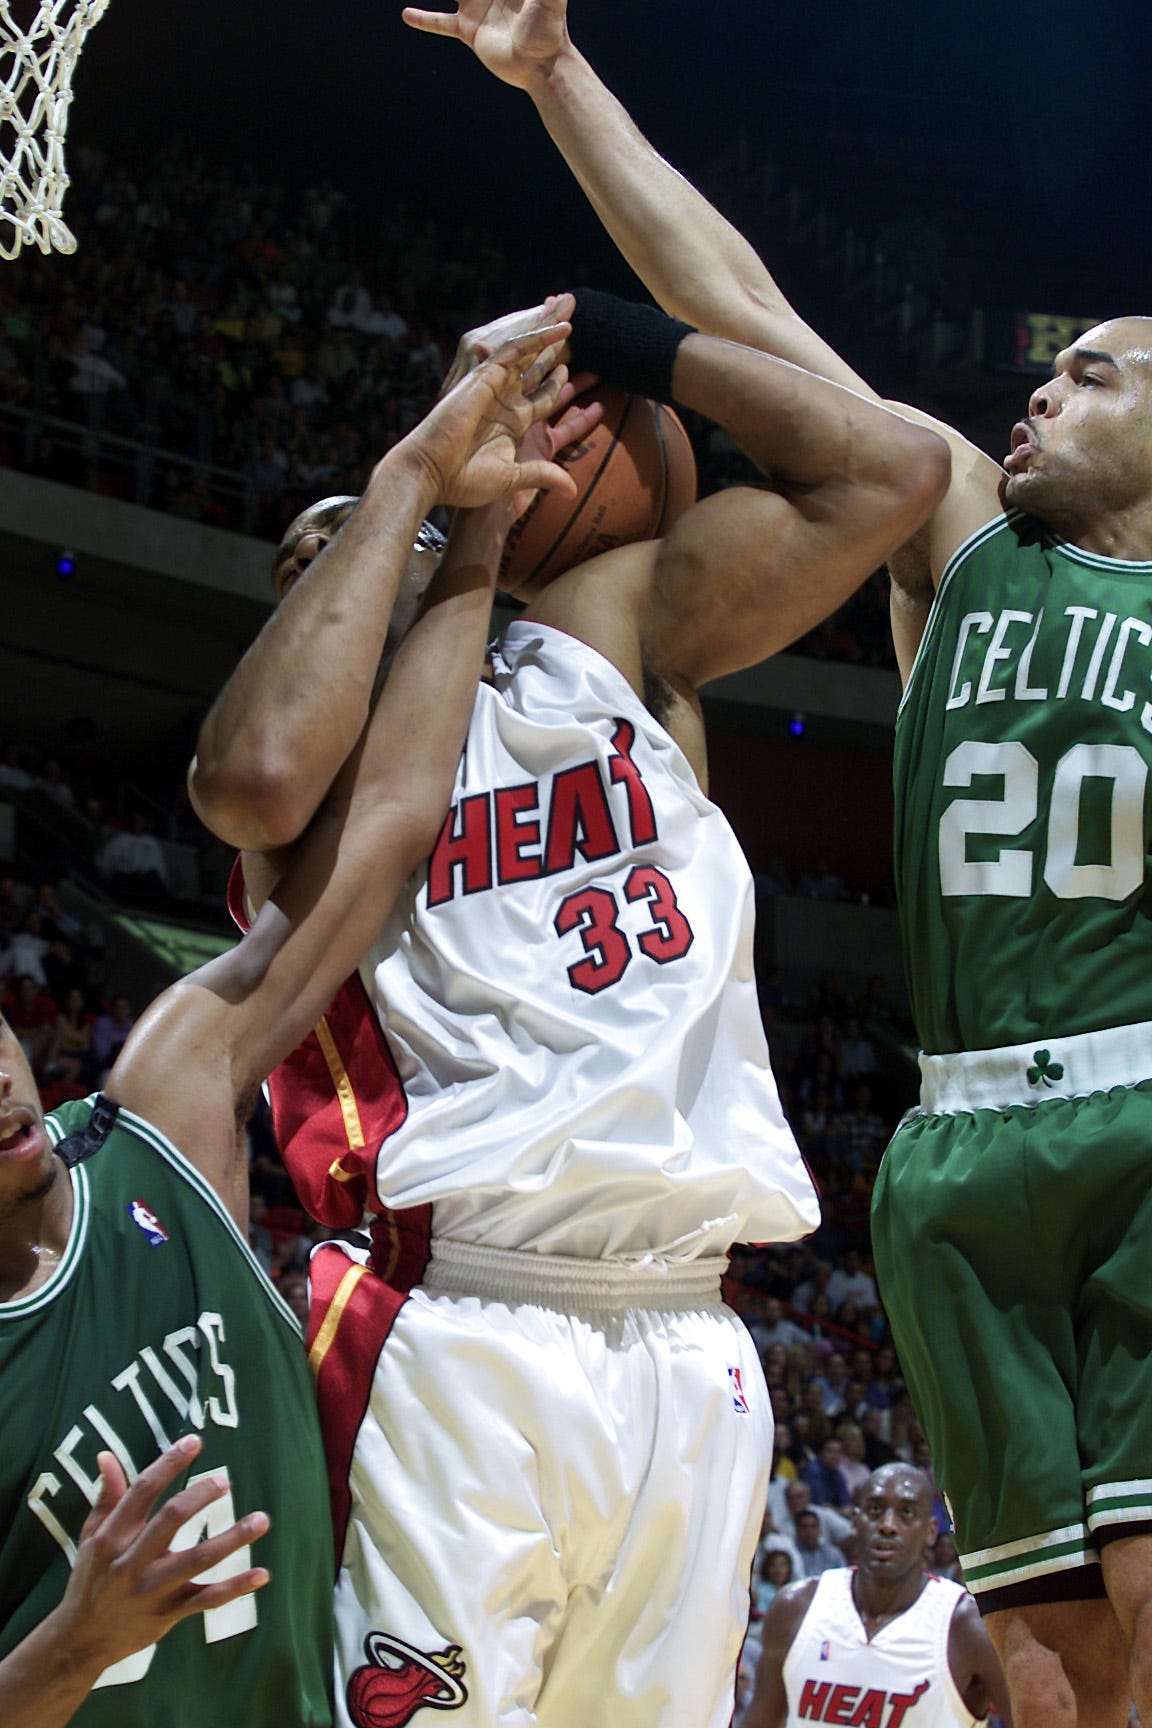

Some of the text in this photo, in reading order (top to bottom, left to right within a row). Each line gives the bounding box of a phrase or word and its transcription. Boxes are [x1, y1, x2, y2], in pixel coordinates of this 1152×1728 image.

[946, 606, 1152, 734] CELTIC
[426, 716, 658, 910] HEAT
[938, 741, 1148, 901] 20
[553, 864, 694, 995] 33
[798, 1678, 930, 1728] HEAT
